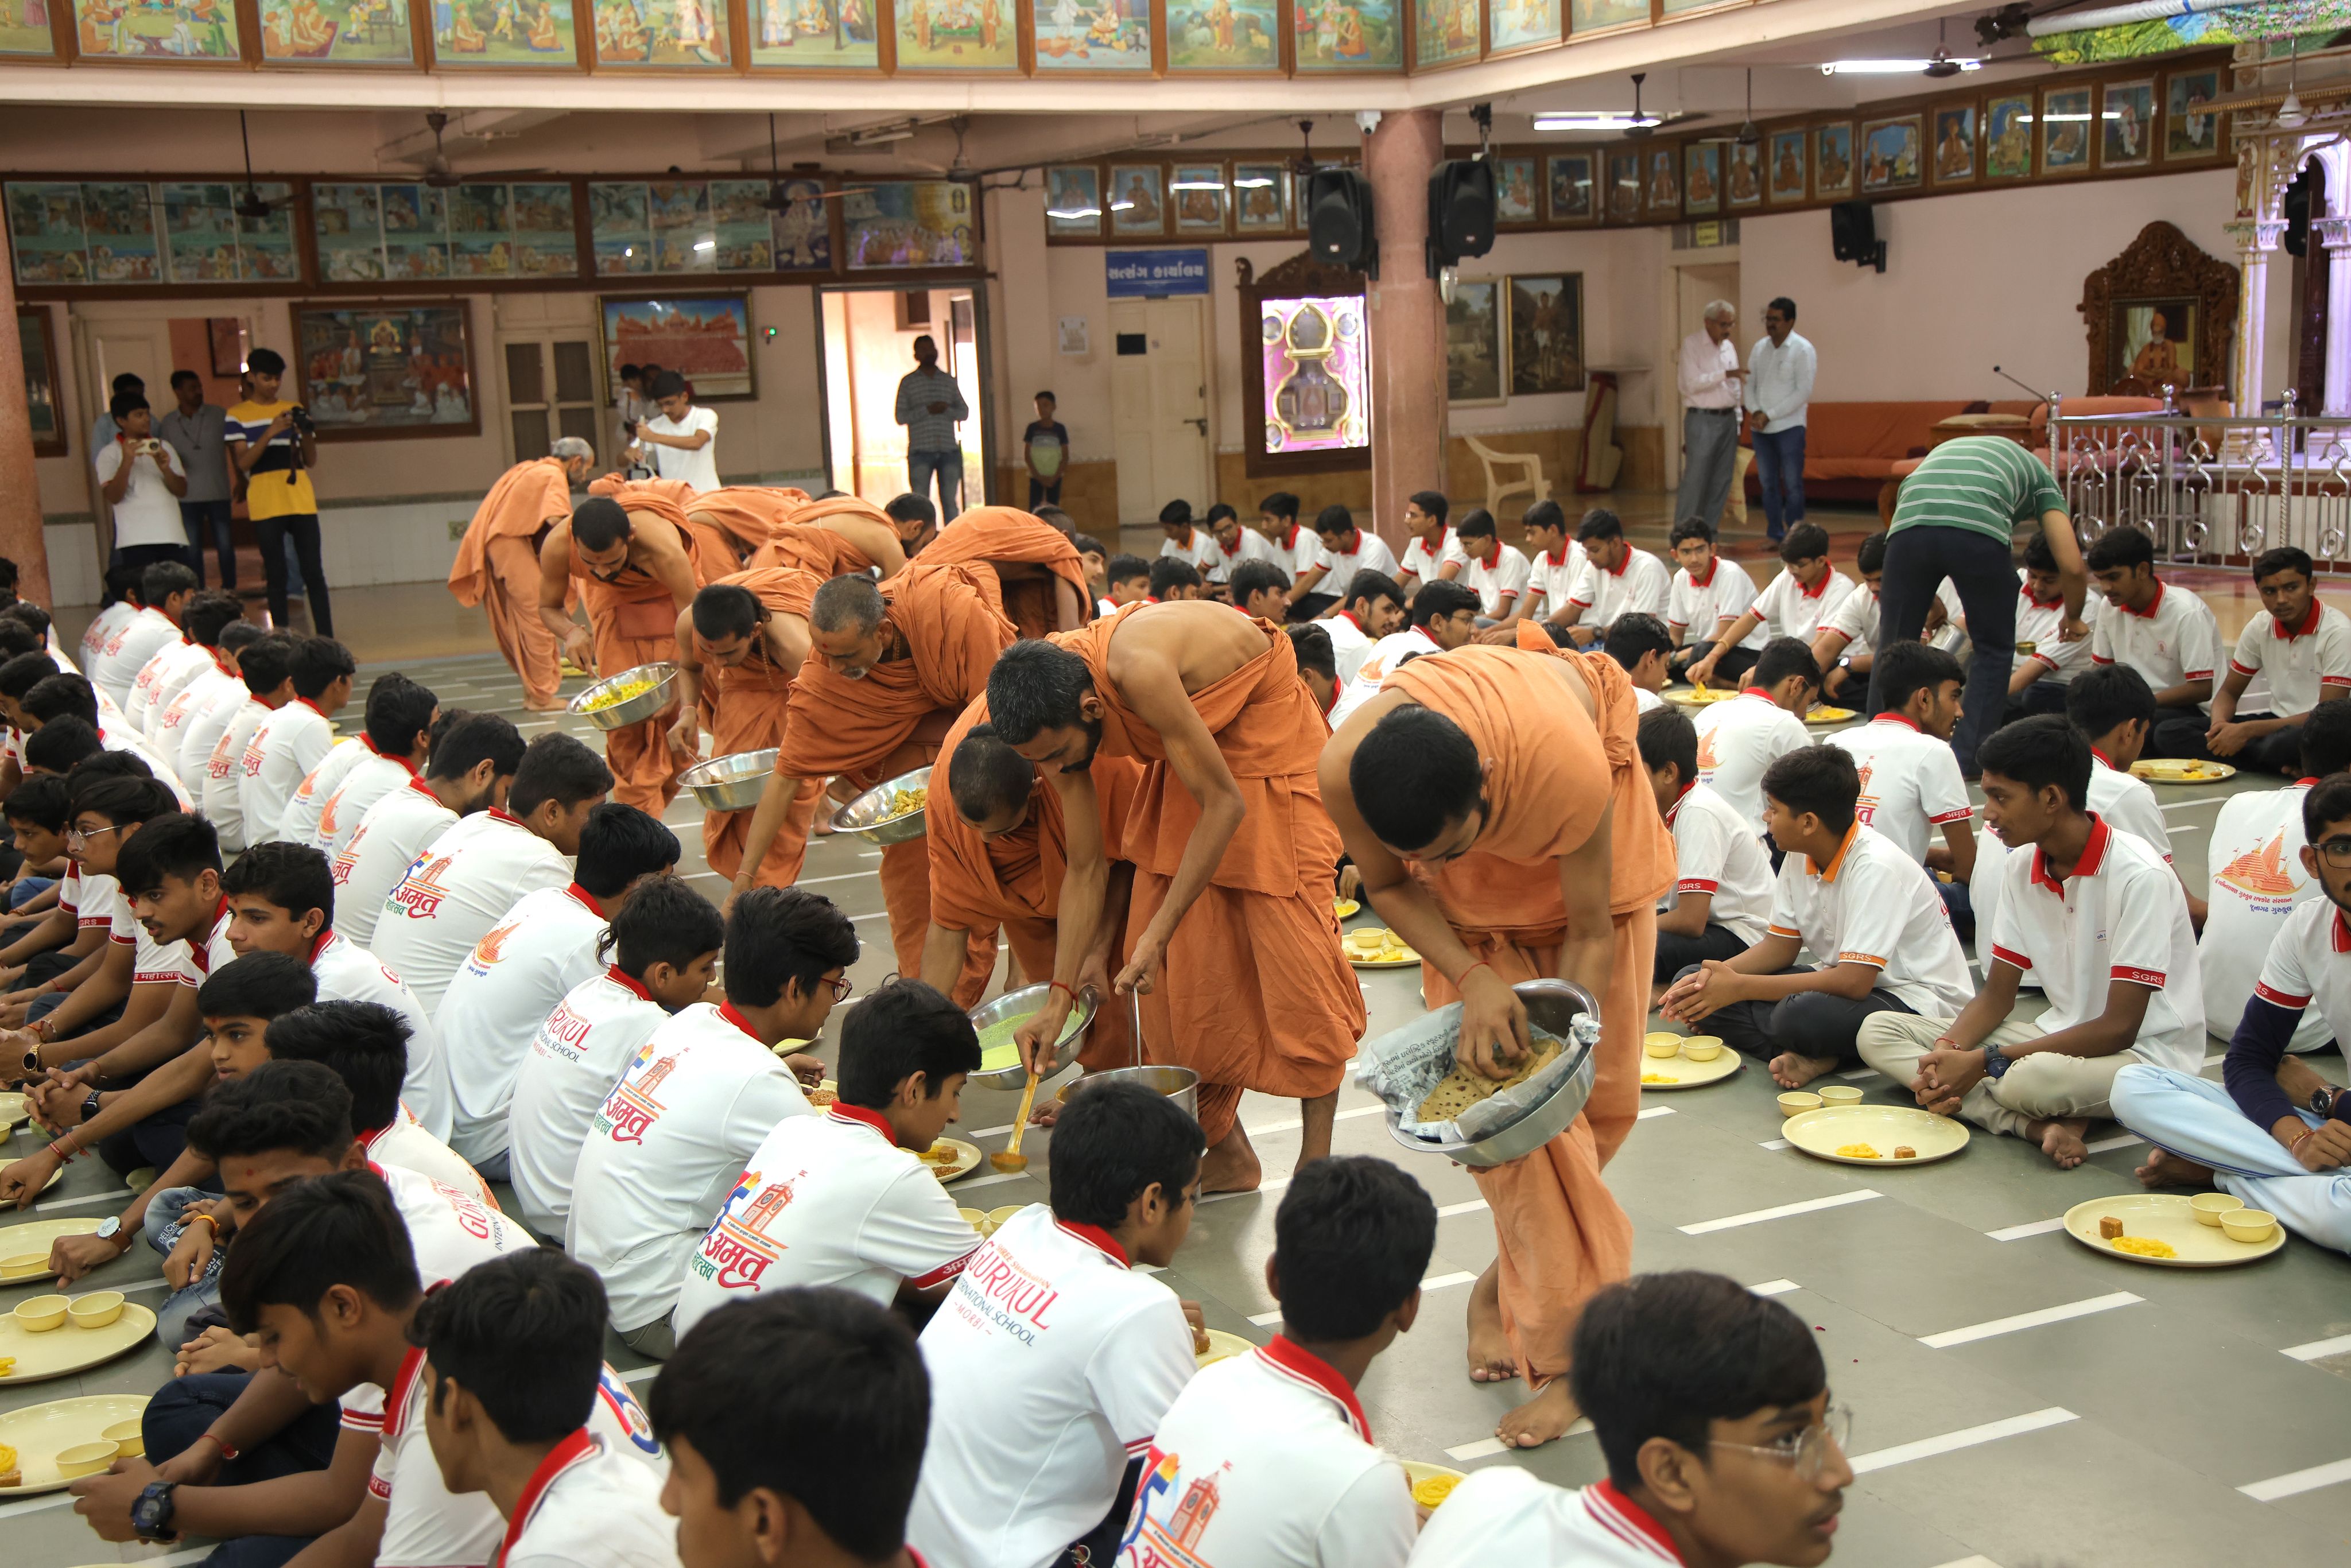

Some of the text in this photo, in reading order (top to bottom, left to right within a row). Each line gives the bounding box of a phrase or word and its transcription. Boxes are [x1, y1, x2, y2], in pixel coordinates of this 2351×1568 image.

[1153, 260, 1204, 278] કાર્યાલય
[332, 861, 354, 886] मृत
[395, 887, 443, 919] अमृत
[2239, 891, 2253, 901] ગુરુકુલ
[2253, 895, 2270, 903] રાજકોટ
[2271, 906, 2292, 914] ગુરુકુલ
[1842, 953, 1872, 962] SGRS
[2132, 971, 2163, 984] SGRS
[2257, 984, 2268, 995] RS
[546, 1005, 592, 1051] RUKUL
[550, 1041, 580, 1063] SCHOOL
[606, 1096, 655, 1146] अमृत
[705, 1232, 774, 1292] अमृत
[968, 1240, 1058, 1330] GURUKUL
[956, 1277, 1036, 1347] TERNATIONAL SCHOOL
